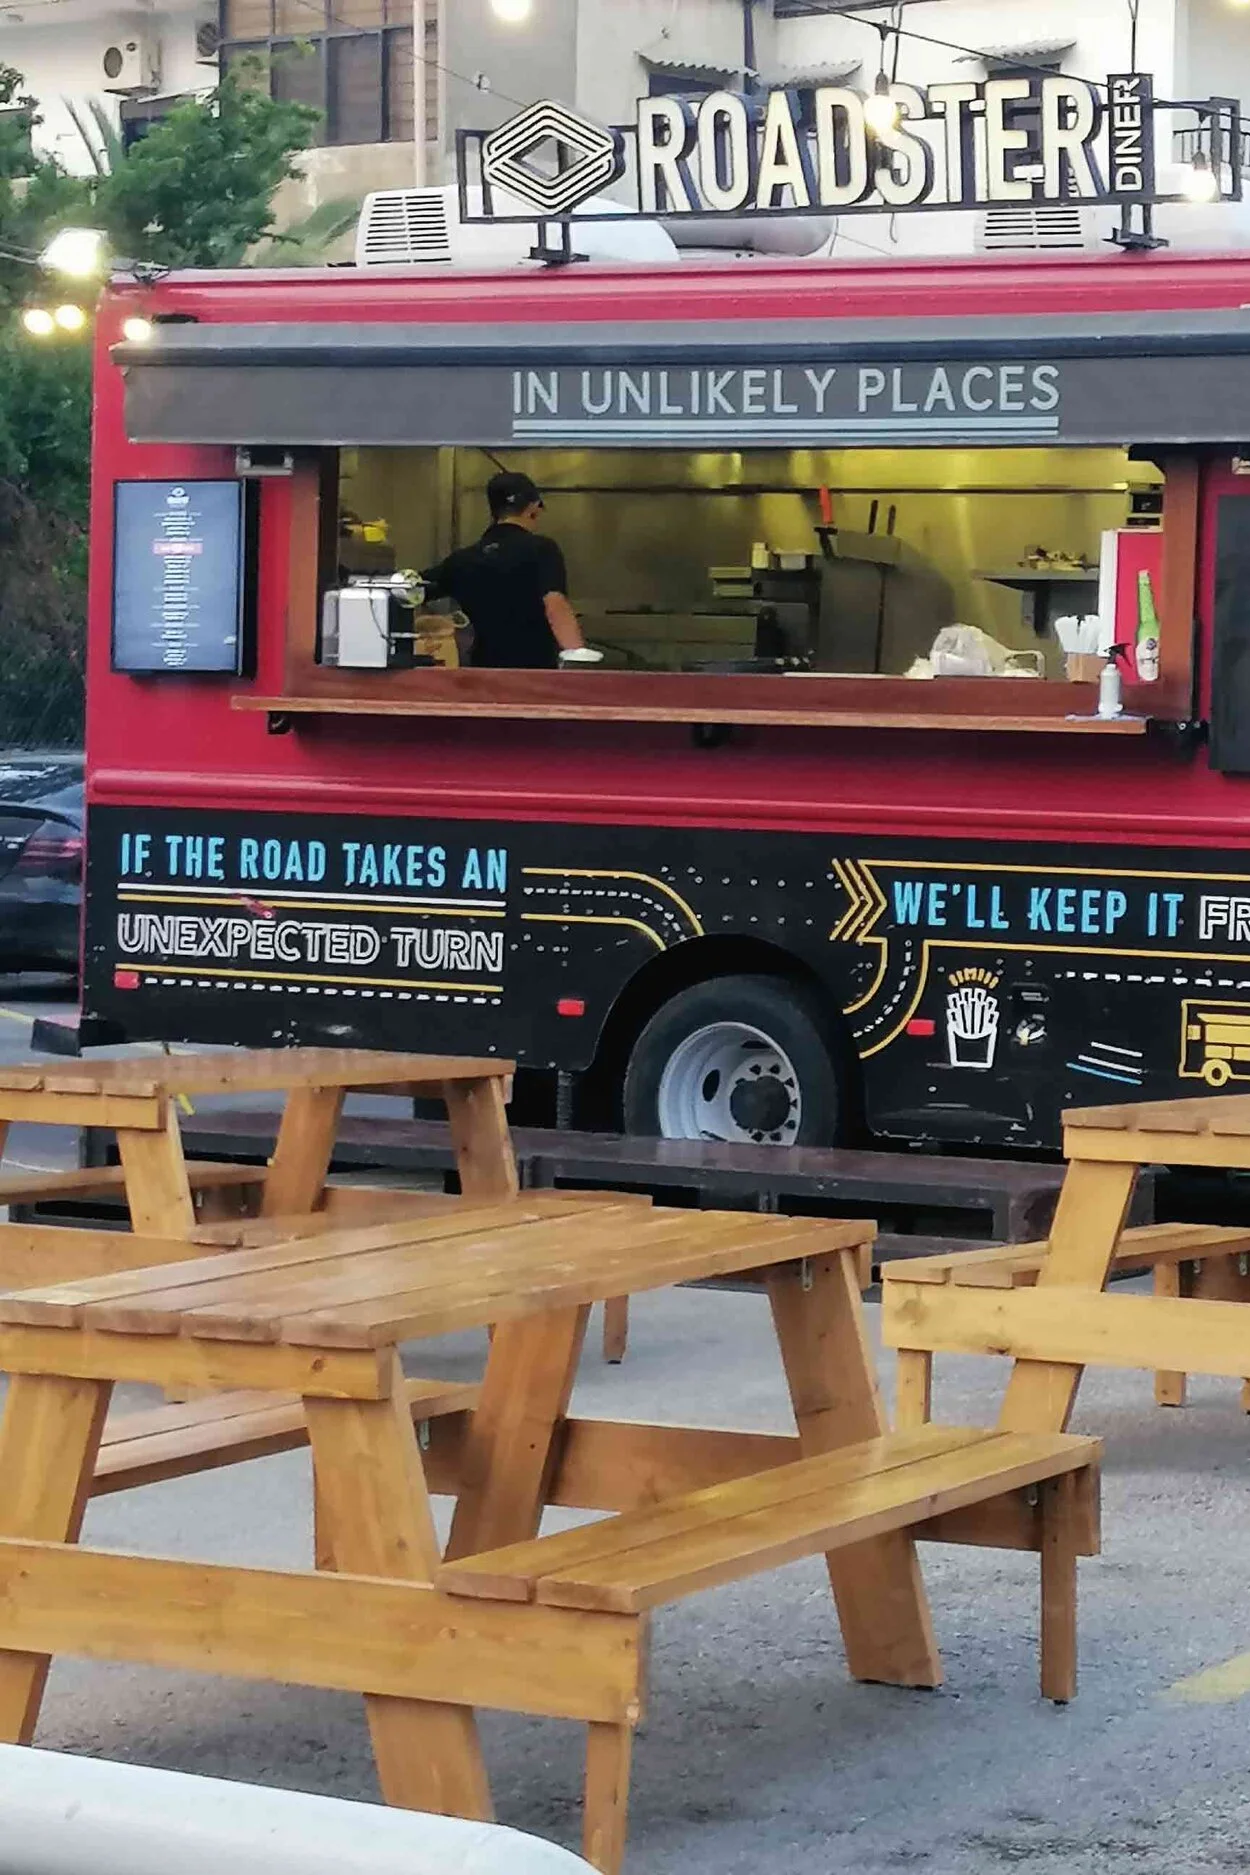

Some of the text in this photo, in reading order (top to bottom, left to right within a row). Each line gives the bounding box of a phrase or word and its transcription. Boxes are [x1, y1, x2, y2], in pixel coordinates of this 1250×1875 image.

[637, 77, 1098, 213] ROADSTER
[1113, 78, 1142, 191] DINER
[511, 365, 1060, 415] IN UNLIKELY PLACES
[121, 833, 508, 893] IF THE ROAD TAKES AN
[893, 880, 1010, 930] WE'LL
[1026, 887, 1127, 934] KEEP
[1147, 892, 1185, 938] IT
[117, 912, 505, 973] UNEXPECTED TURN
